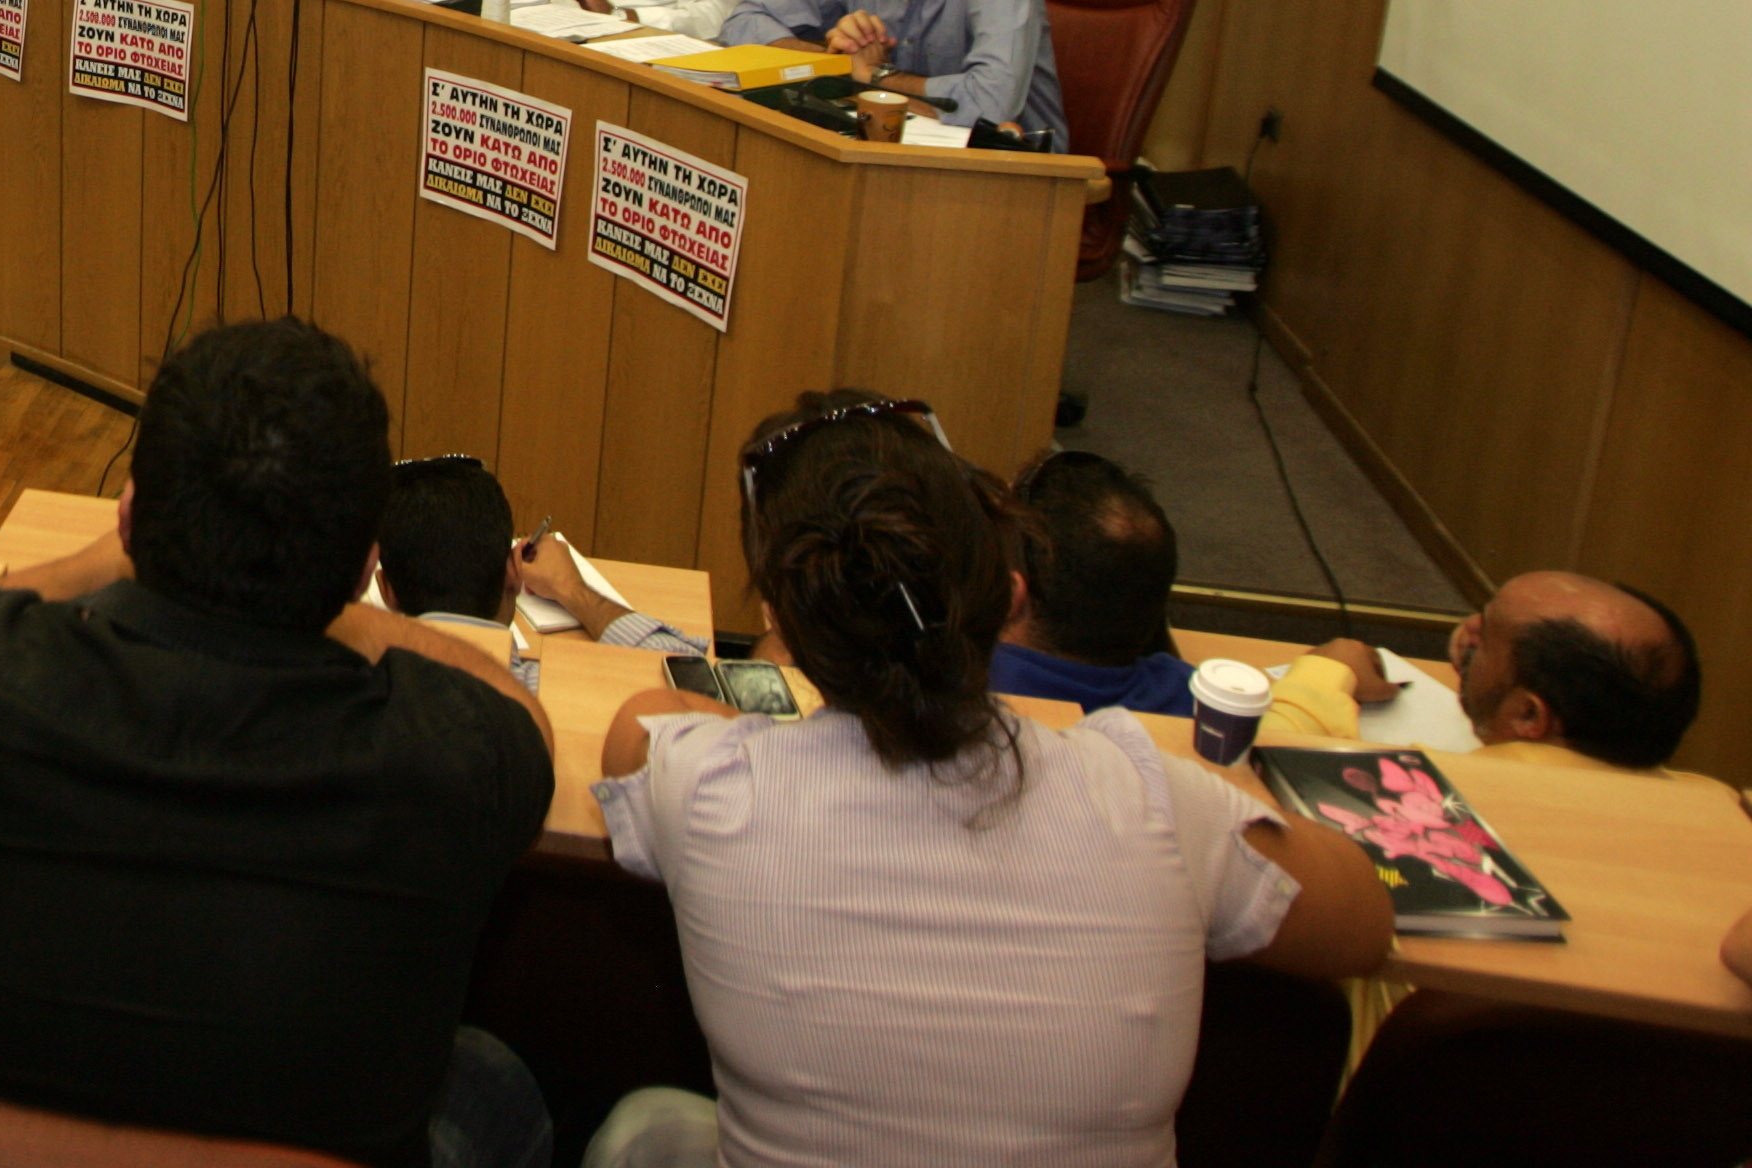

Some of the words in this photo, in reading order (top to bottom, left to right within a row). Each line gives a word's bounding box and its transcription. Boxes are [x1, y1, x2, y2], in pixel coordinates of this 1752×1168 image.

[78, 25, 114, 42] ΖΟΥΝ
[120, 33, 154, 51] ΚΑΤΩ
[158, 43, 184, 60] ΑΠΟ
[79, 10, 116, 27] 2.500.000
[170, 29, 185, 43] ΜΑΣ
[137, 4, 151, 18] ΤΗ
[155, 8, 187, 27] ΧΩΡΑ
[77, 41, 92, 54] ΤΟ
[96, 45, 126, 60] ΟΡΙΟ
[130, 51, 183, 76] ΦΤΩΧΕΙΑΣ
[432, 100, 476, 125] 2.500.000
[543, 137, 561, 156] ΜΑΣ
[450, 88, 498, 112] ΑΥΤΗΝ
[503, 102, 520, 120] ΤΗ
[526, 109, 563, 136] ΧΩΡΑ
[430, 138, 448, 154] ΤΟ
[453, 145, 487, 167] ΟΡΙΟ
[491, 158, 556, 194] ΦΤΩΧΕΙΑΣ
[432, 120, 474, 144] ΖΟΥΝ
[480, 133, 522, 160] ΚΑΤΩ
[527, 151, 558, 175] ΑΠΟ
[622, 144, 668, 176] ΑΥΤΗΝ
[674, 164, 692, 186] ΤΗ
[696, 174, 738, 206] ΧΩΡΑ
[426, 174, 484, 204] ΔΙΚΑΙΩΜΑ
[486, 193, 502, 211] ΝΑ
[504, 200, 519, 217] ΤΟ
[521, 208, 552, 235] ΞΕΧΝΑ
[428, 157, 473, 184] ΚΑΝΕΙΣ
[476, 173, 502, 194] ΜΑΣ
[505, 184, 528, 204] ΔΕΝ
[530, 193, 554, 217] ΕΧΕΙ
[602, 157, 645, 188] 2.500.000
[714, 205, 736, 228] ΜΑΣ
[602, 177, 643, 208] ΖΟΥΝ
[648, 197, 692, 230] ΚΑΤΩ
[696, 220, 732, 249] ΑΠΟ
[597, 219, 642, 251] ΚΑΝΕΙΣ
[644, 240, 670, 265] ΜΑΣ
[671, 254, 696, 279] ΔΕΝ
[697, 268, 727, 295] ΕΧΕΙ
[600, 197, 618, 216] ΤΟ
[622, 207, 655, 233] ΟΡΙΟ
[659, 225, 729, 271] ΦΤΩΧΕΙΑΣ
[595, 236, 650, 274] ΔΙΚΑΙΩΜΑ
[652, 263, 668, 284] ΝΑ
[670, 273, 686, 292] ΤΟ
[687, 282, 724, 314] ΞΕΧΝΑ
